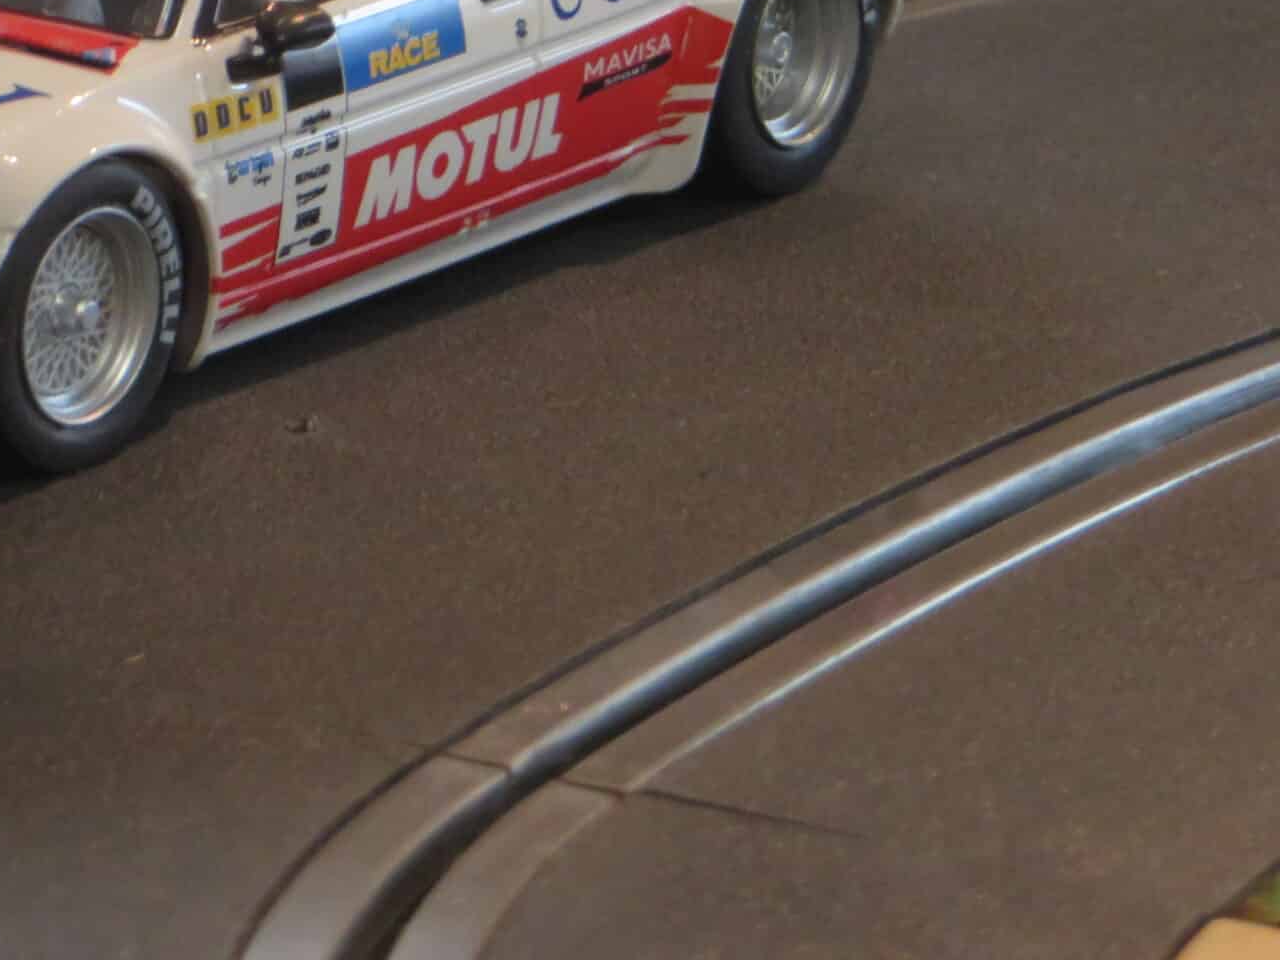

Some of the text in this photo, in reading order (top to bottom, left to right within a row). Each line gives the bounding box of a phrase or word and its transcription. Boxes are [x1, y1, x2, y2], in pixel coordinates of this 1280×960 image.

[368, 30, 441, 80] RACE
[582, 32, 673, 83] MAVISA
[353, 91, 564, 230] MOTUL
[131, 184, 183, 344] PIRELLI
